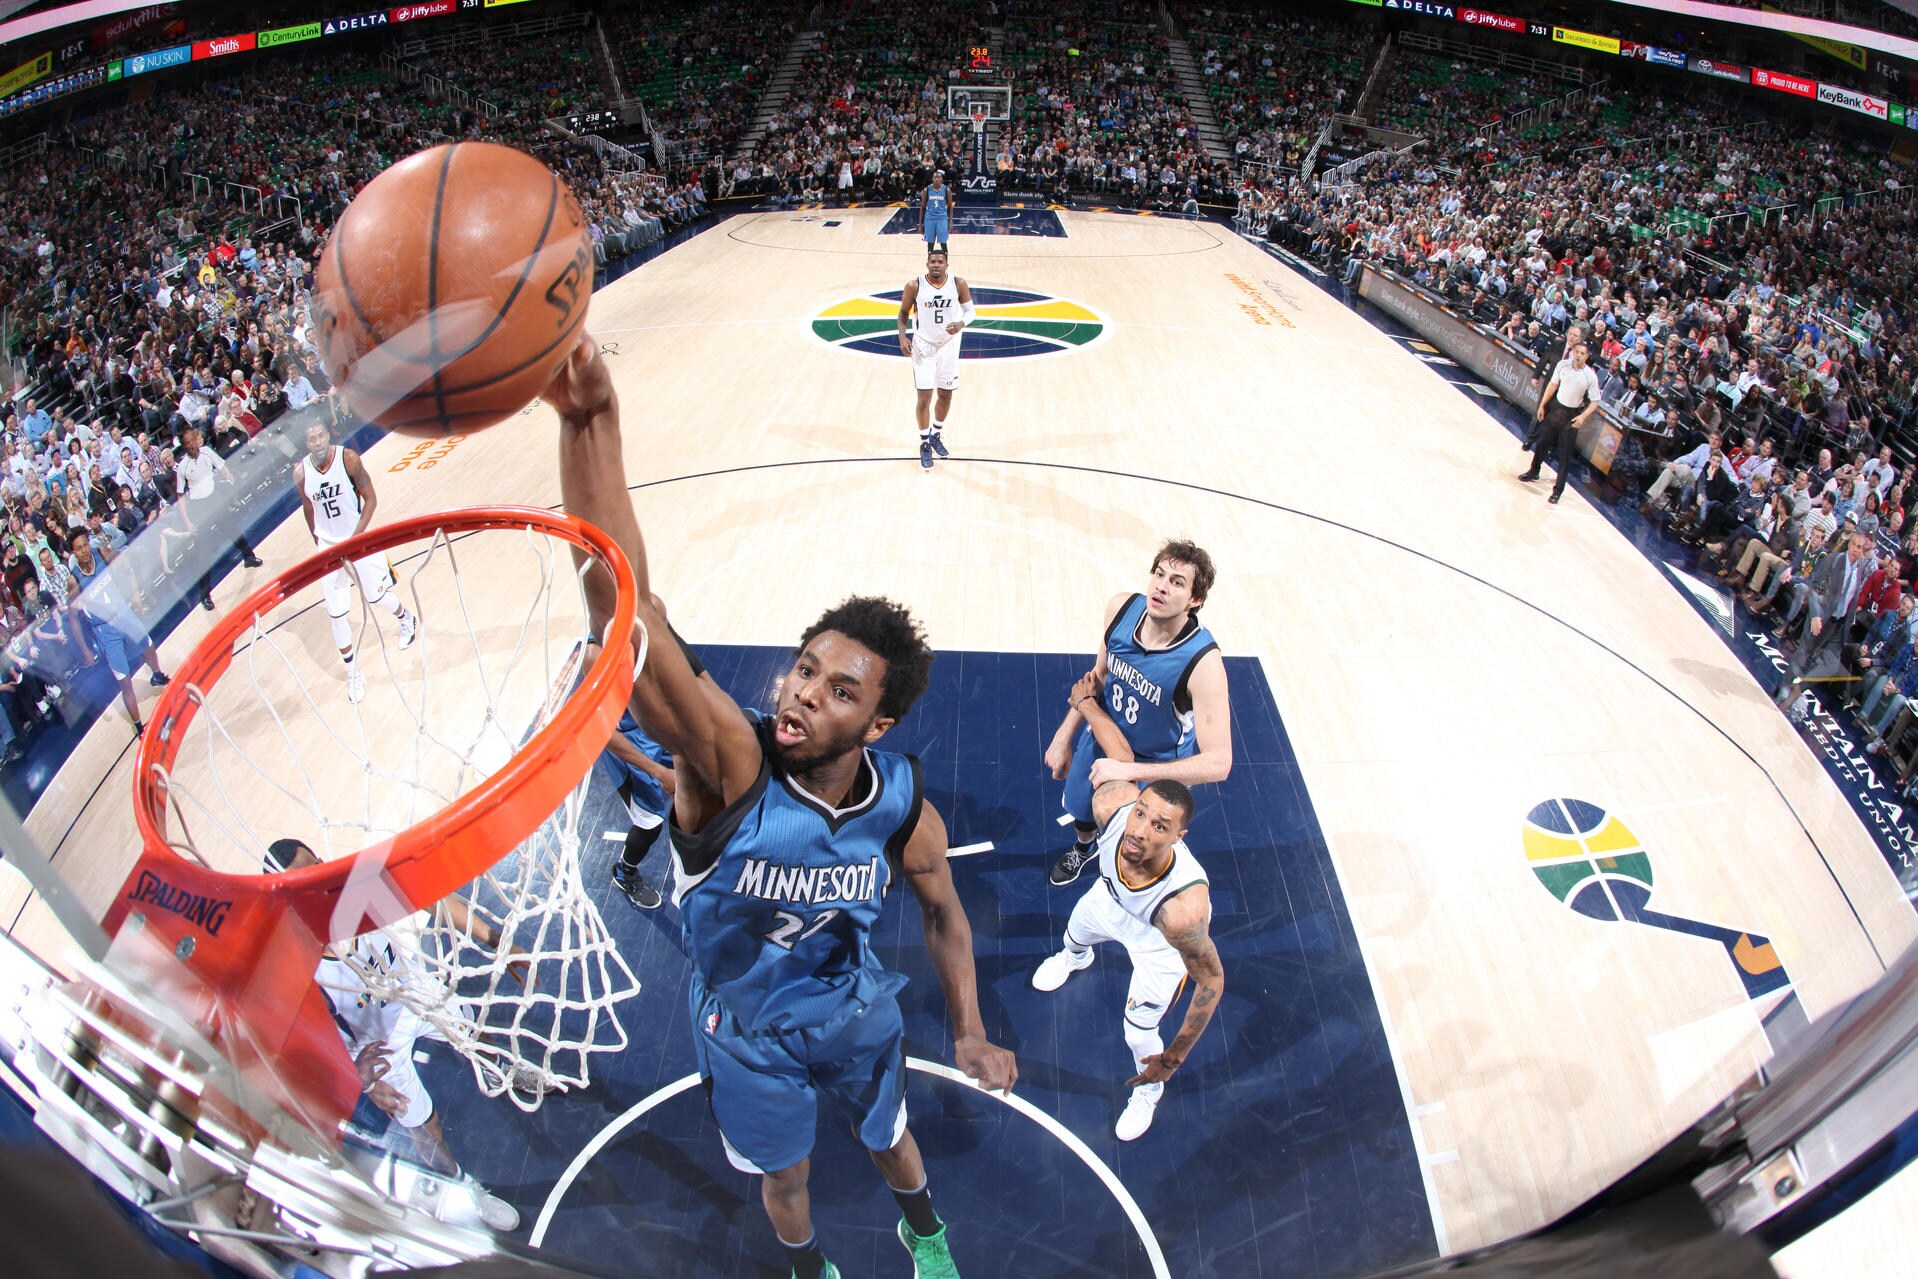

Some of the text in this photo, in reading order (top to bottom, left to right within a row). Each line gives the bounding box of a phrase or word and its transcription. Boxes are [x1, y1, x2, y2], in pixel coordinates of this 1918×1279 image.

[1403, 0, 1454, 17] DELTA
[339, 13, 387, 31] DELTA
[1531, 25, 1547, 36] 7:31
[272, 27, 319, 43] CenturyLink
[209, 39, 239, 55] Smith's
[147, 50, 183, 68] NU SKIN
[972, 55, 990, 67] 24
[1713, 61, 1740, 73] TOYOTA
[1819, 88, 1861, 109] KeyBank
[934, 200, 939, 208] 5
[924, 295, 953, 309] JAZZ
[934, 309, 944, 324] 6
[1490, 357, 1520, 389] Ashley
[312, 482, 344, 502] JAZZ
[322, 499, 341, 519] 15
[1106, 651, 1162, 707] MINNESOTA
[1112, 683, 1140, 725] 88
[1859, 791, 1914, 868] UNION
[732, 855, 879, 906] MINNESOTA
[127, 869, 233, 937] SPALDING
